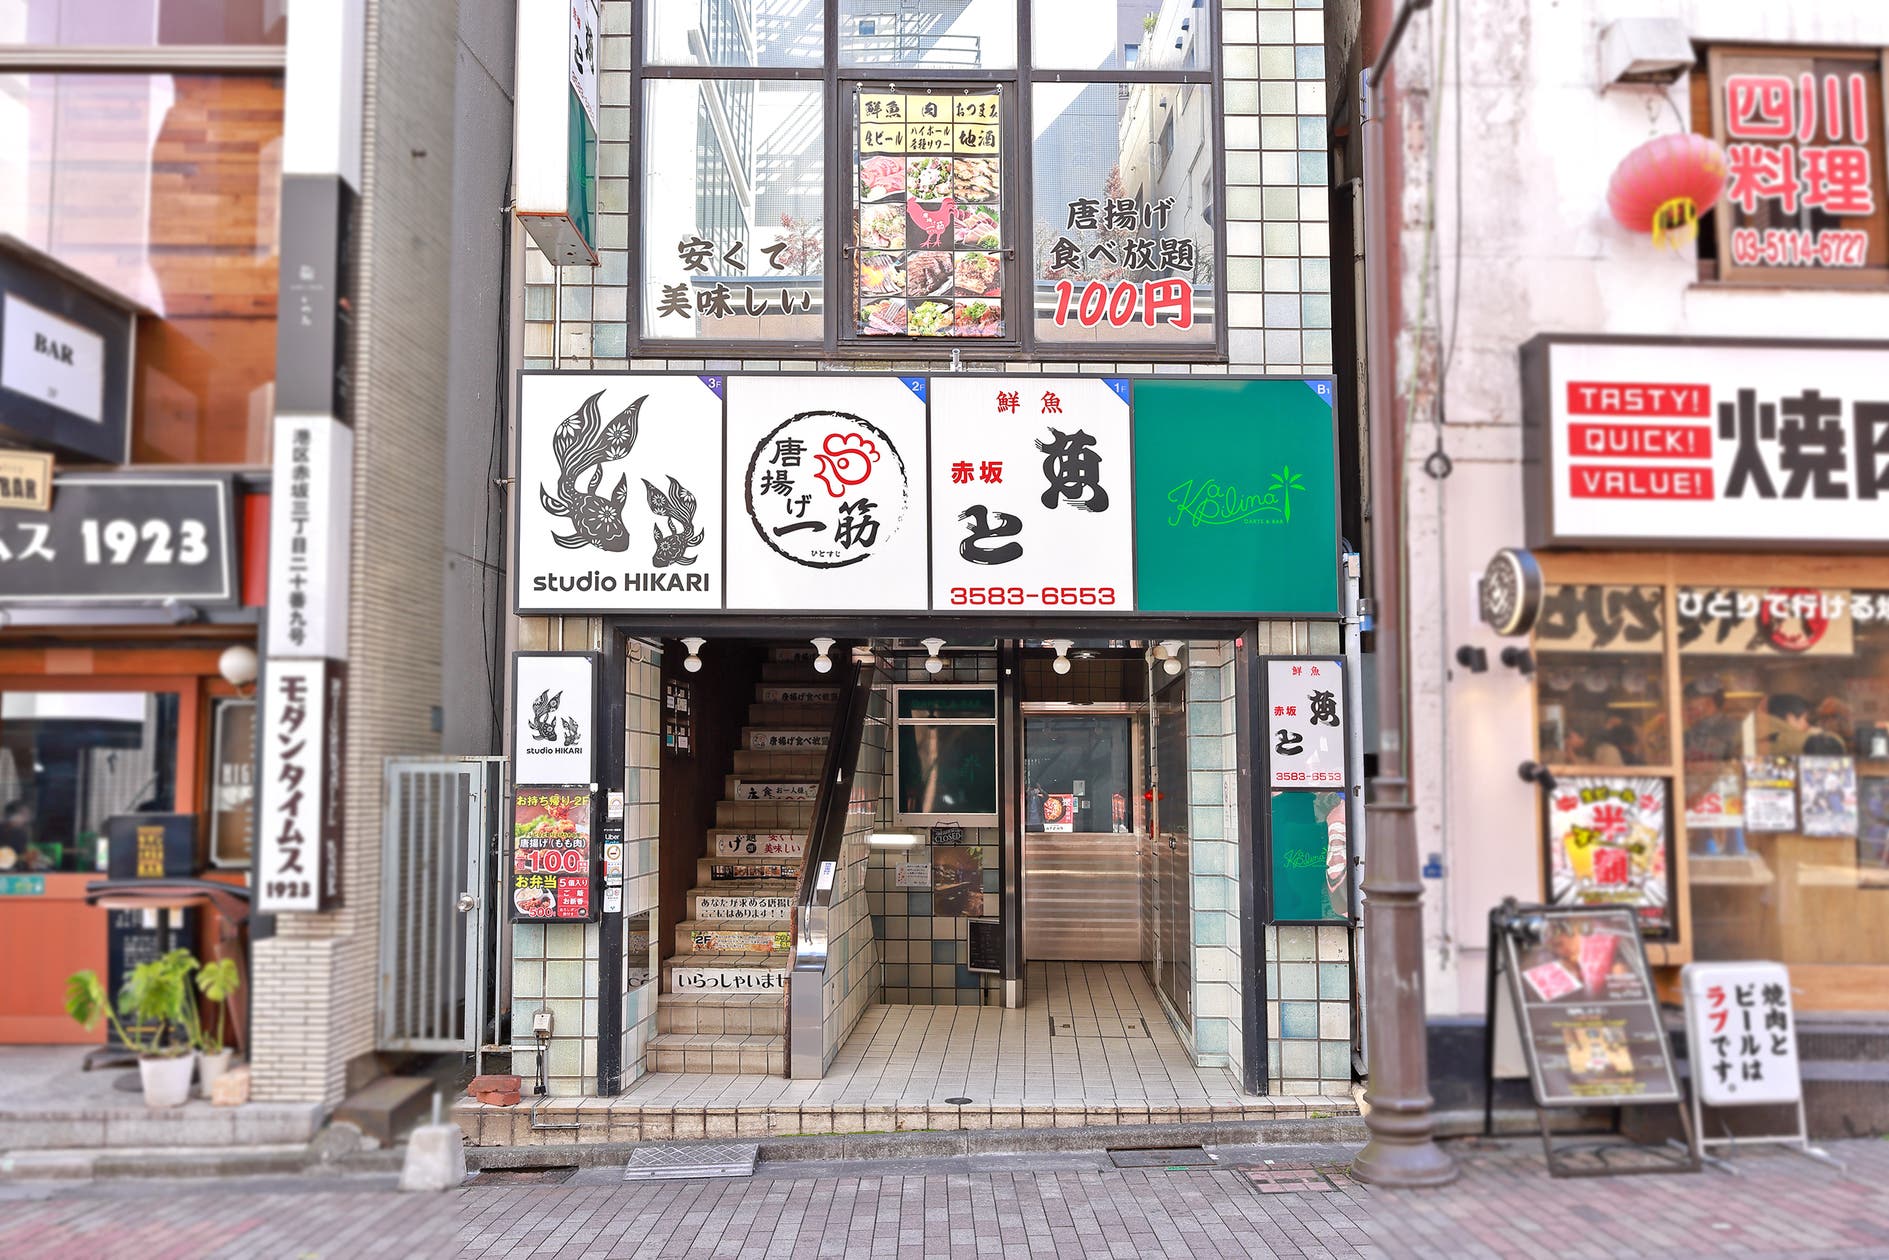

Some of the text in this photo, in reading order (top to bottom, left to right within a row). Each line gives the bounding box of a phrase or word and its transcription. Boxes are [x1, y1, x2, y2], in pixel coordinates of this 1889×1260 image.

[865, 101, 902, 119] 鮮魚
[922, 102, 938, 118] 肉
[1727, 74, 1868, 142] 四川
[865, 130, 903, 147] 生ビール
[959, 129, 996, 147] 地酒
[1729, 145, 1873, 213] 料理
[1067, 198, 1175, 230] 唐揚げ
[678, 237, 788, 272] 安くて
[1050, 238, 1194, 271] 食べ放題
[1734, 231, 1867, 265] 03-5114-6727
[656, 284, 811, 319] 美味しい
[1055, 280, 1192, 328] 100円
[34, 333, 74, 366] BAR
[708, 378, 722, 388] 3F
[912, 382, 924, 391] 2F
[1114, 383, 1126, 393] 1F
[996, 391, 1063, 414] 鮮魚
[1580, 387, 1699, 412] TASTY!
[1586, 429, 1695, 453] QUICK!
[951, 461, 1003, 484] 赤坂
[1583, 471, 1702, 495] VALUE!
[773, 498, 880, 549] 一筋
[82, 519, 208, 565] 1923
[811, 549, 841, 558] ひとすじ
[533, 571, 709, 592] studio HIKARI
[950, 587, 1116, 605] 3583-6553
[1274, 706, 1297, 716] 赤坂
[526, 746, 553, 754] studio
[275, 676, 308, 875] モダンタイムス
[1276, 772, 1342, 781] 3583-6553
[517, 795, 590, 806] お持ち帰り 2F
[764, 844, 801, 853] 美味しい
[266, 881, 311, 898] 1923
[515, 875, 557, 889] お弁当
[695, 936, 711, 944] 2F
[1761, 982, 1788, 1056] 焼肉と
[1735, 983, 1763, 1082] ビールは
